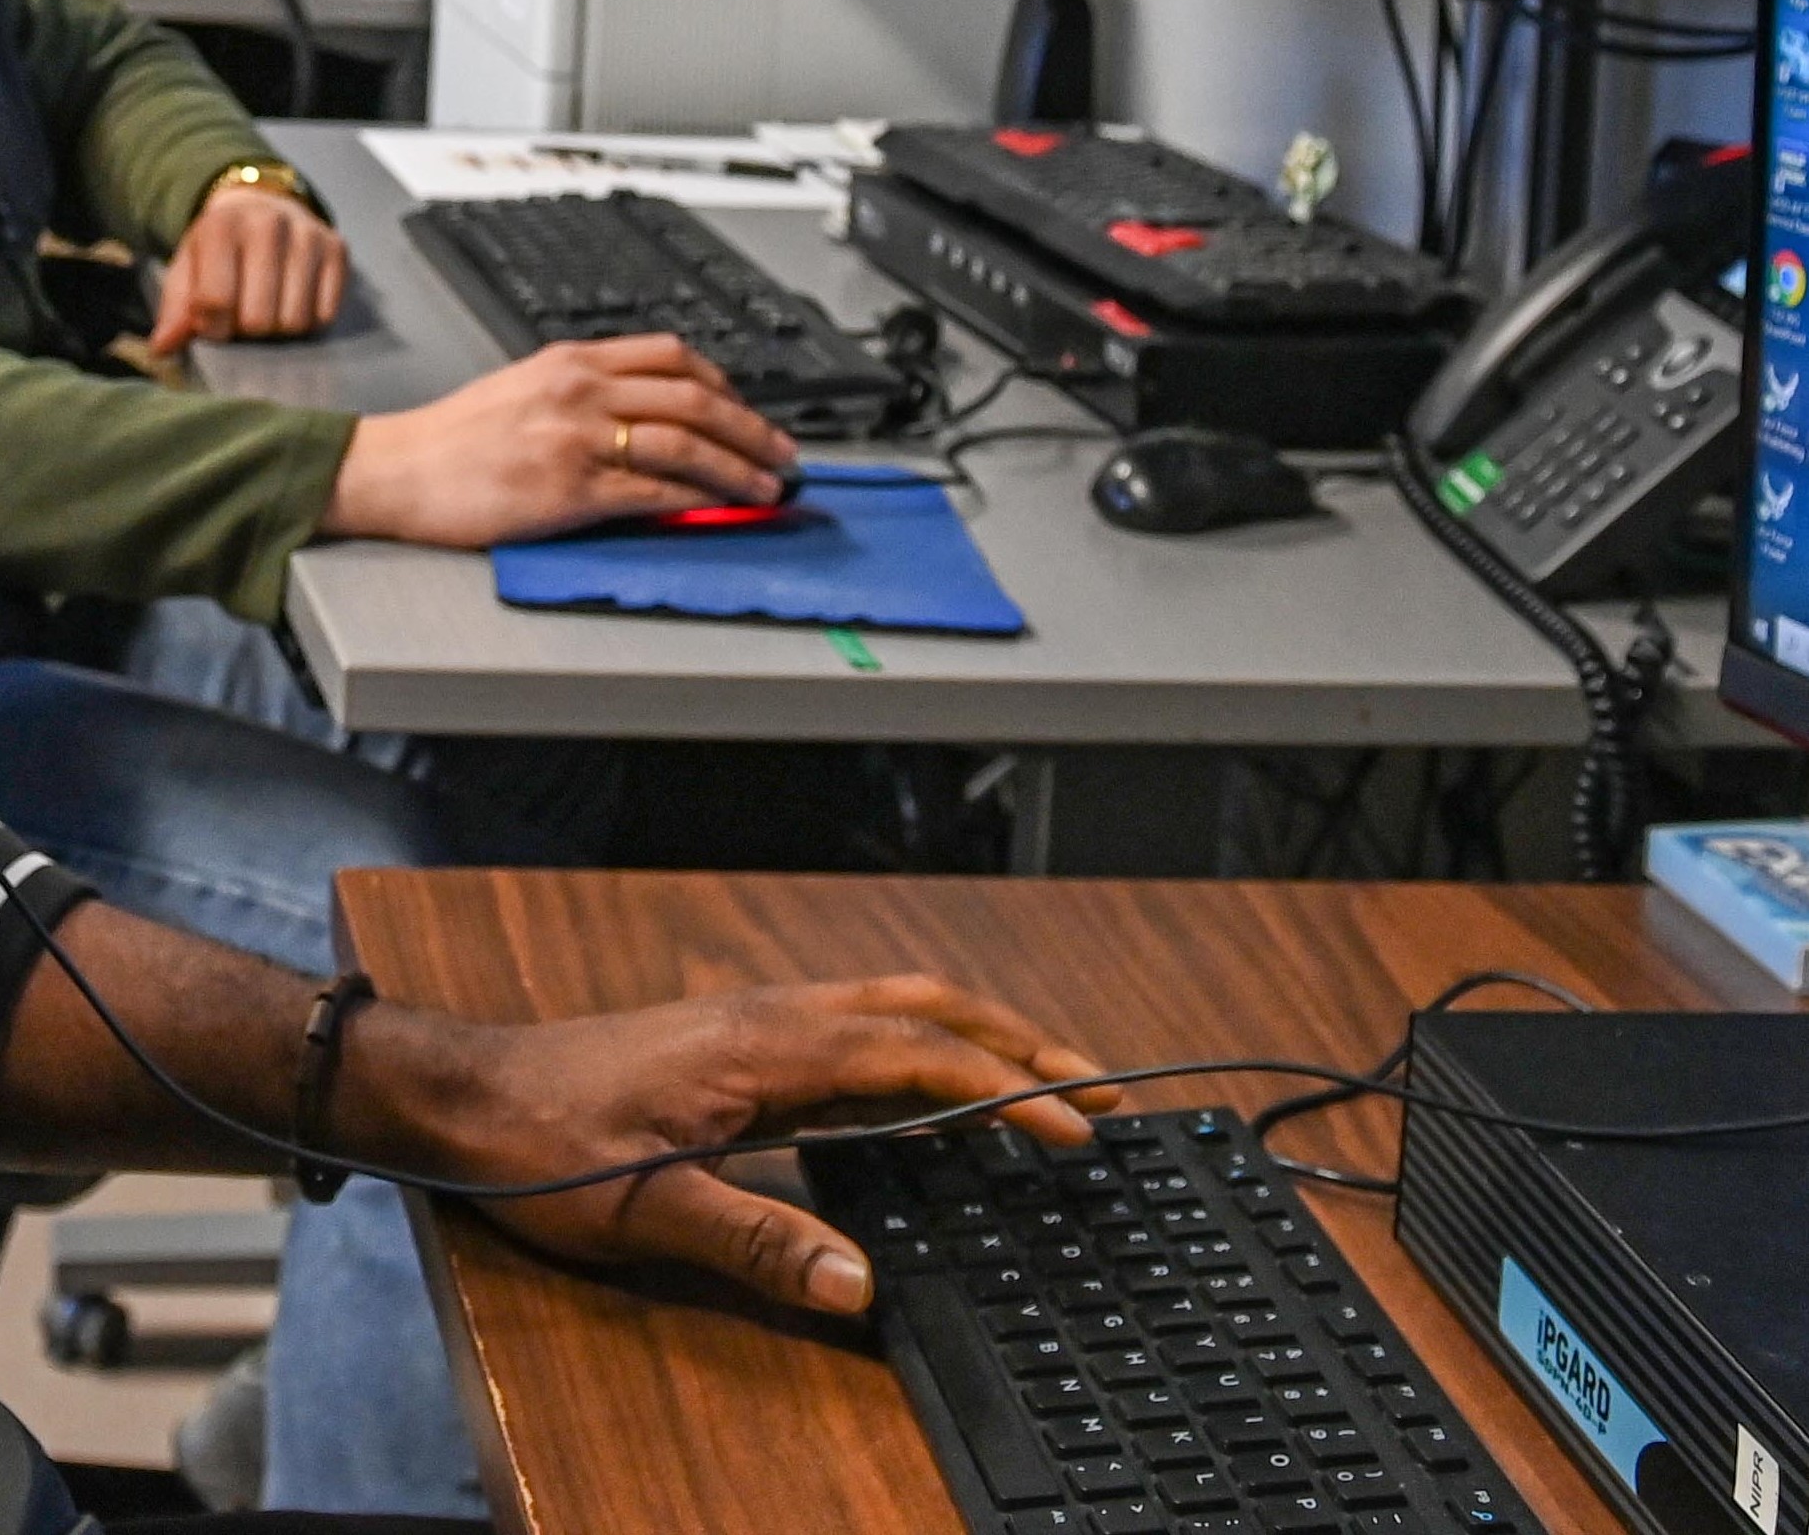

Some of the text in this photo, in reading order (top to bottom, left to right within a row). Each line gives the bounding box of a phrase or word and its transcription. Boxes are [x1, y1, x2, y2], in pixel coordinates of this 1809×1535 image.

[982, 1236, 1001, 1248] X
[1001, 1270, 1020, 1282] C
[1021, 1304, 1040, 1316] V
[1039, 1341, 1059, 1353] B
[1059, 1379, 1081, 1392] N
[1081, 1417, 1103, 1432] M
[1042, 1213, 1215, 1485] S D F G H J K L
[1128, 1232, 1148, 1243] E
[1150, 1265, 1169, 1277] R
[1173, 1299, 1193, 1311] T
[1196, 1335, 1216, 1348] Y
[1219, 1373, 1240, 1386] U
[1270, 1454, 1290, 1467] O
[1296, 1497, 1317, 1509] P
[1536, 1309, 1612, 1423] iPGARD
[1258, 1351, 1276, 1361] 7
[1283, 1390, 1301, 1400] 8
[1309, 1429, 1327, 1440] 9
[1336, 1471, 1354, 1481] 0
[1474, 1490, 1491, 1504] F9
[1749, 1450, 1765, 1519] NIPR
